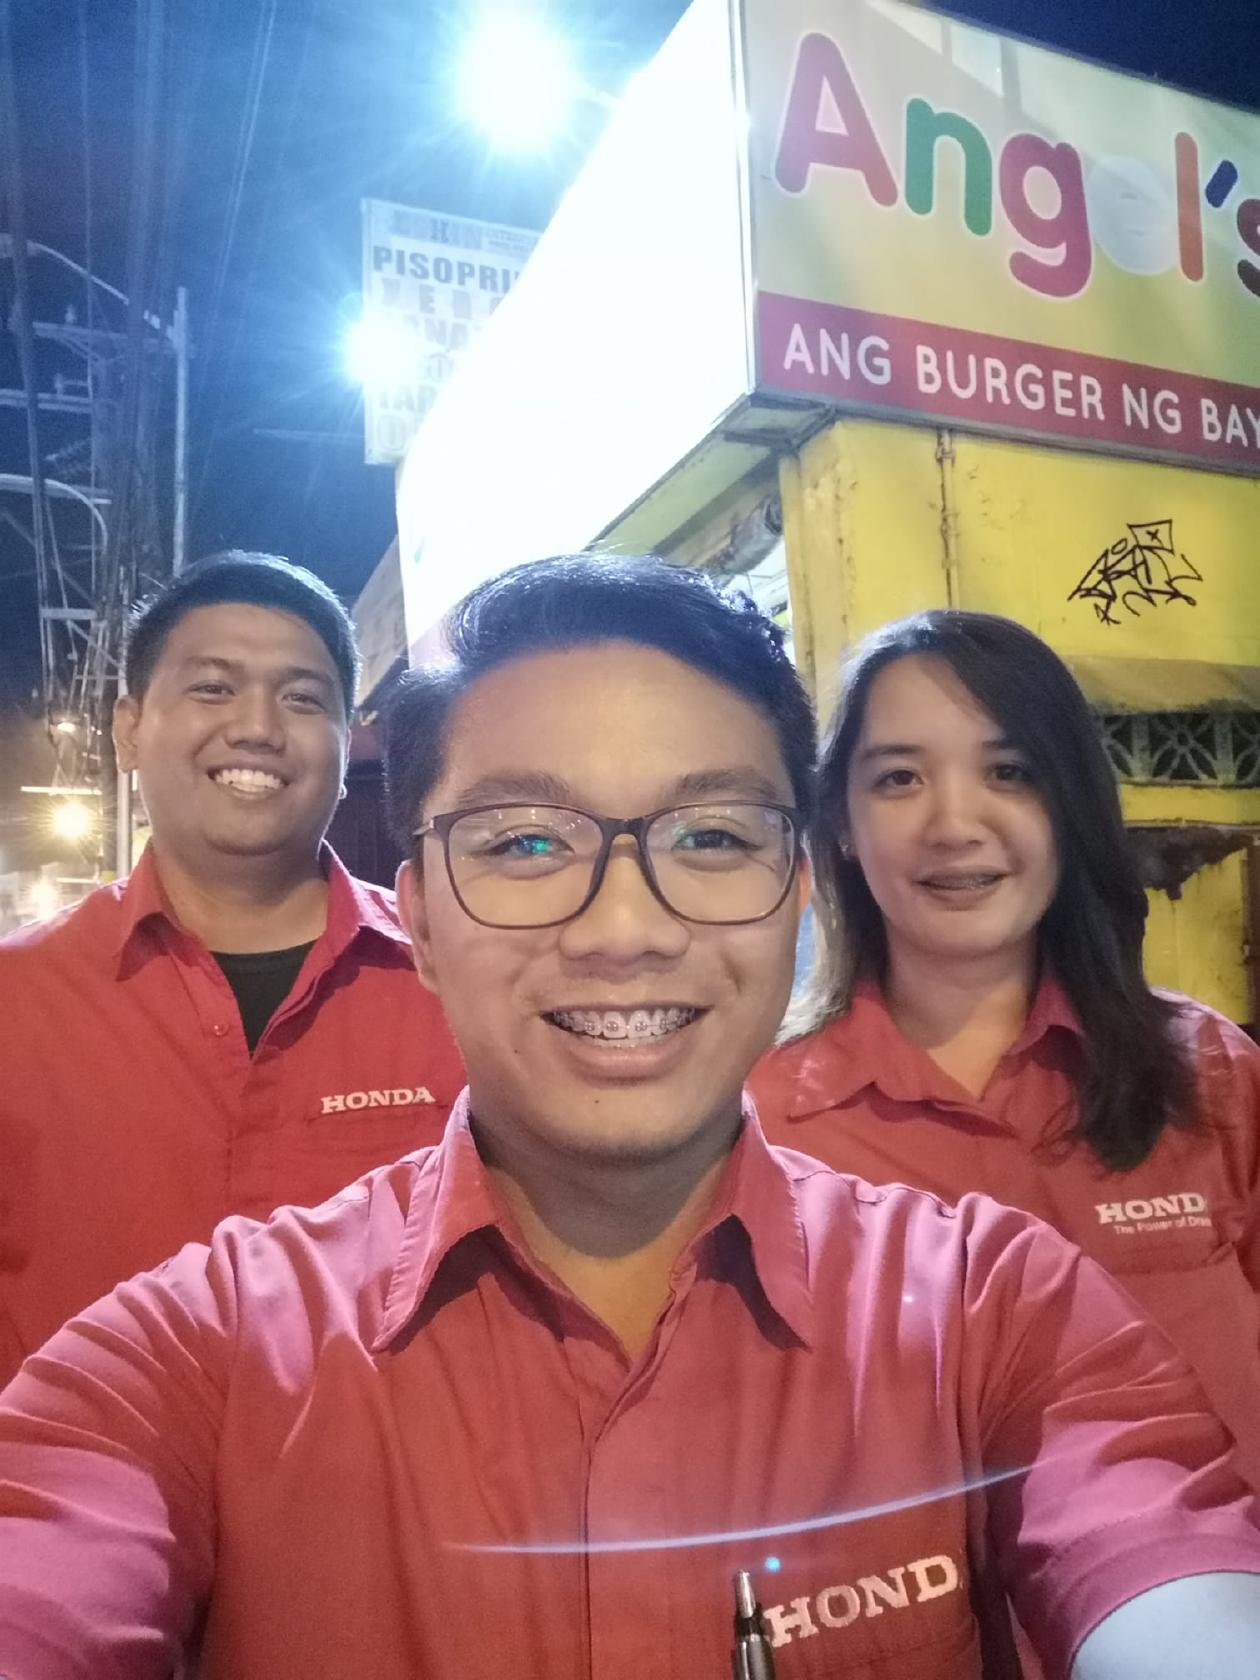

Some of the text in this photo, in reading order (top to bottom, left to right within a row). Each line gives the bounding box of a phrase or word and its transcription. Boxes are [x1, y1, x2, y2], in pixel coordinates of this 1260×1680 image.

[373, 245, 519, 294] PISOPRI
[783, 323, 892, 386] ANG
[915, 344, 1105, 421] BURGER
[1122, 383, 1182, 434] NG
[321, 1086, 436, 1115] HONDA
[763, 1554, 960, 1648] HOND
